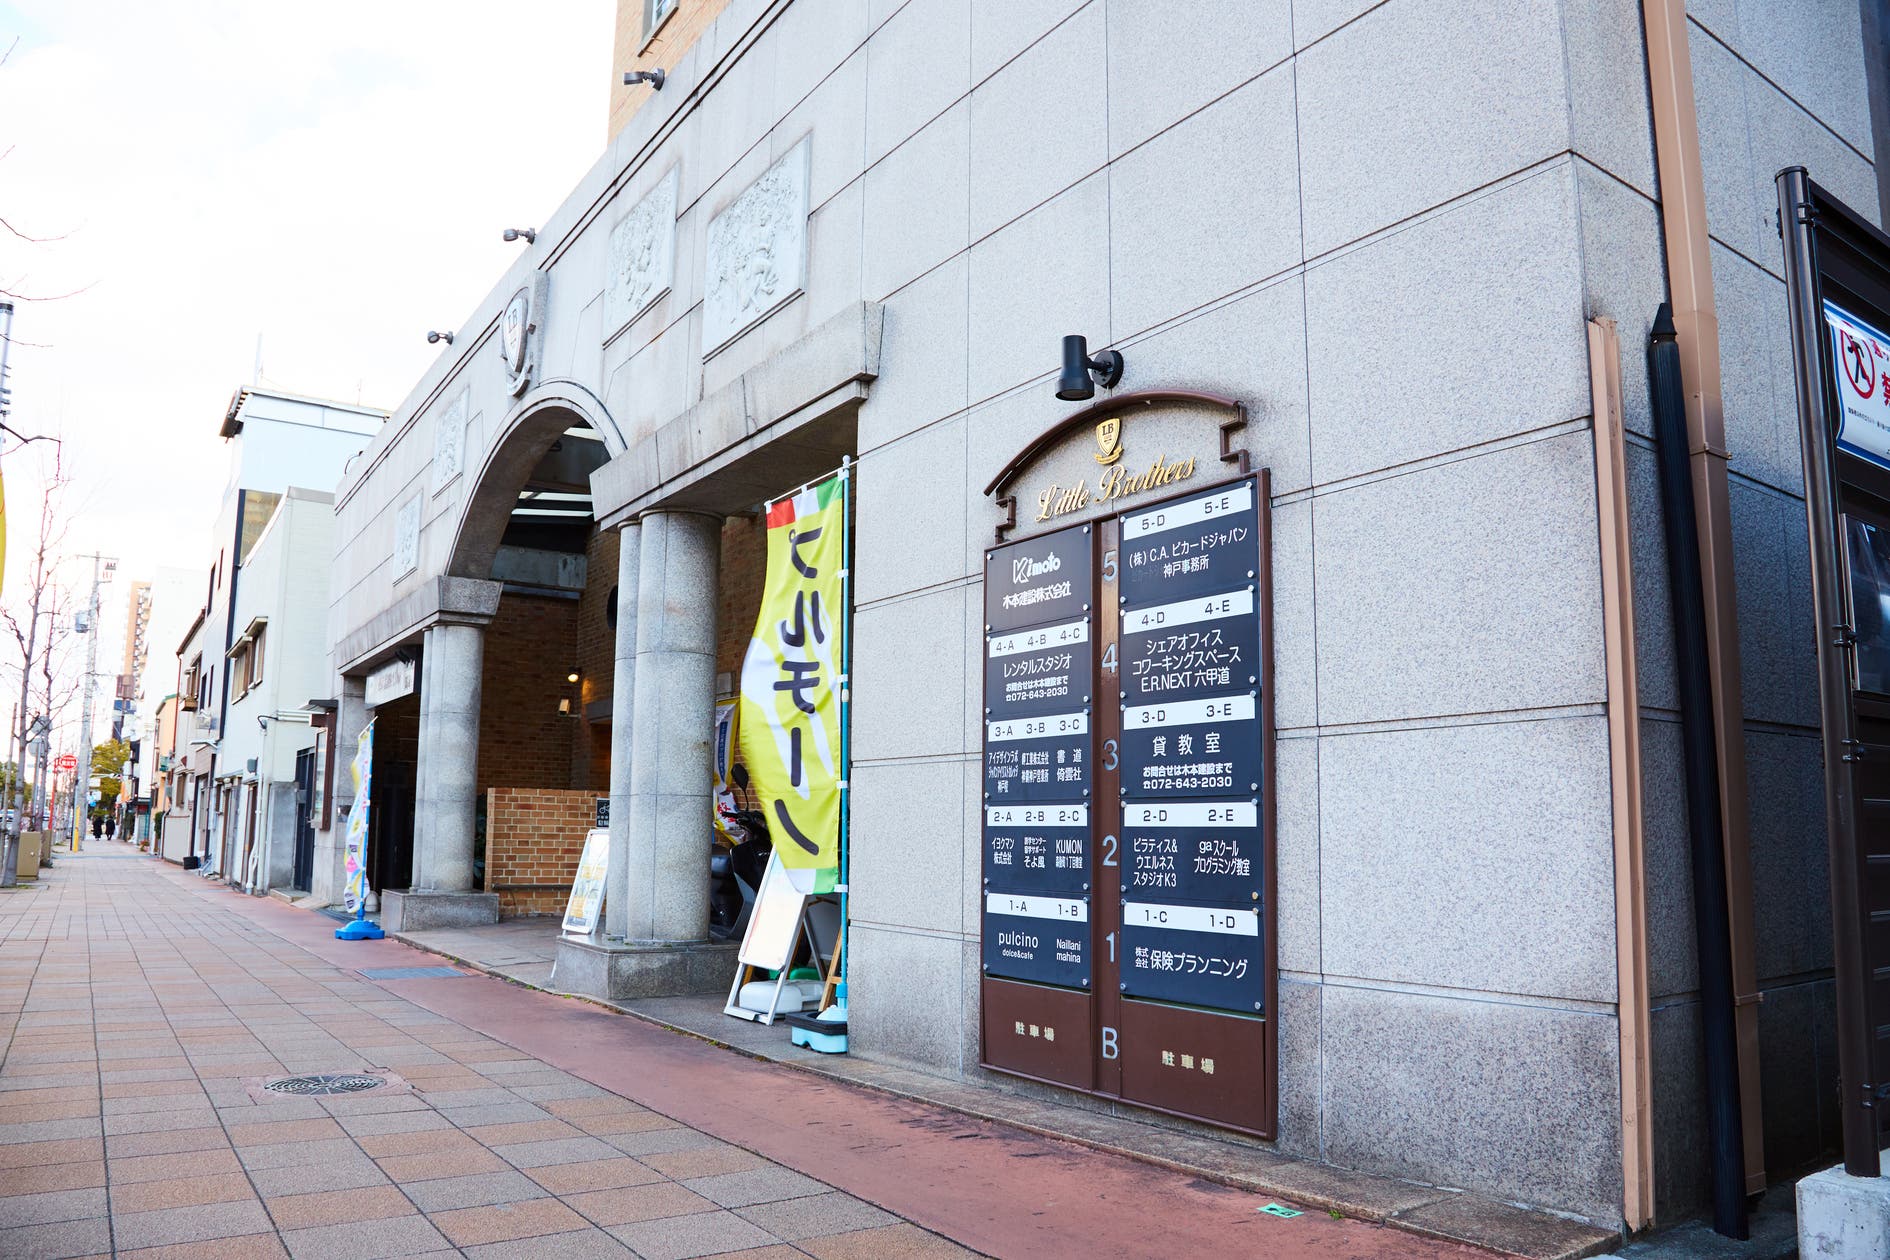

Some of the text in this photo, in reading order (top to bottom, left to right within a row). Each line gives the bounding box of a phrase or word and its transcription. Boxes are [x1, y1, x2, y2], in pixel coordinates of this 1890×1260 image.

[1035, 455, 1196, 522] Little Brothers
[1141, 498, 1230, 530] 5-D 5-E
[1013, 551, 1061, 585] Kimoto
[1101, 551, 1118, 582] 5
[1163, 555, 1210, 579] 神戸事務所
[1141, 600, 1230, 626] 4-D 4-E
[995, 628, 1080, 652] 4-A 4-B 4-C
[1146, 629, 1223, 656] シェアオフィス
[1003, 653, 1072, 678] レンタルスタジオ
[1101, 643, 1118, 674] 4
[1132, 646, 1241, 676] コワーキングスペース
[1142, 703, 1231, 723] 3-D 3-E
[995, 719, 1080, 737] 3-A 3-B 3-C
[1104, 739, 1119, 771] 3
[1143, 763, 1232, 778] お問合せは木本建設まで
[994, 811, 1080, 822] 2-A 2-B 2-C
[1143, 809, 1234, 822] 2-D 2-E
[1055, 839, 1083, 854] KUMON
[1102, 834, 1118, 867] 2
[1133, 837, 1178, 853] ピラティス&
[993, 852, 1013, 865] 株式会社
[1136, 856, 1175, 870] ウエルネス
[1194, 857, 1251, 876] プログラミング教室
[1009, 900, 1079, 917] 1-A 1-B
[1145, 909, 1235, 929] 1-C 1-D
[998, 930, 1039, 949] pulcino
[1105, 932, 1116, 963] 1
[1056, 951, 1081, 964] mahina
[1015, 1021, 1055, 1042] 駐車場
[1102, 1026, 1119, 1060] B
[1161, 1050, 1215, 1075] 駐車場
